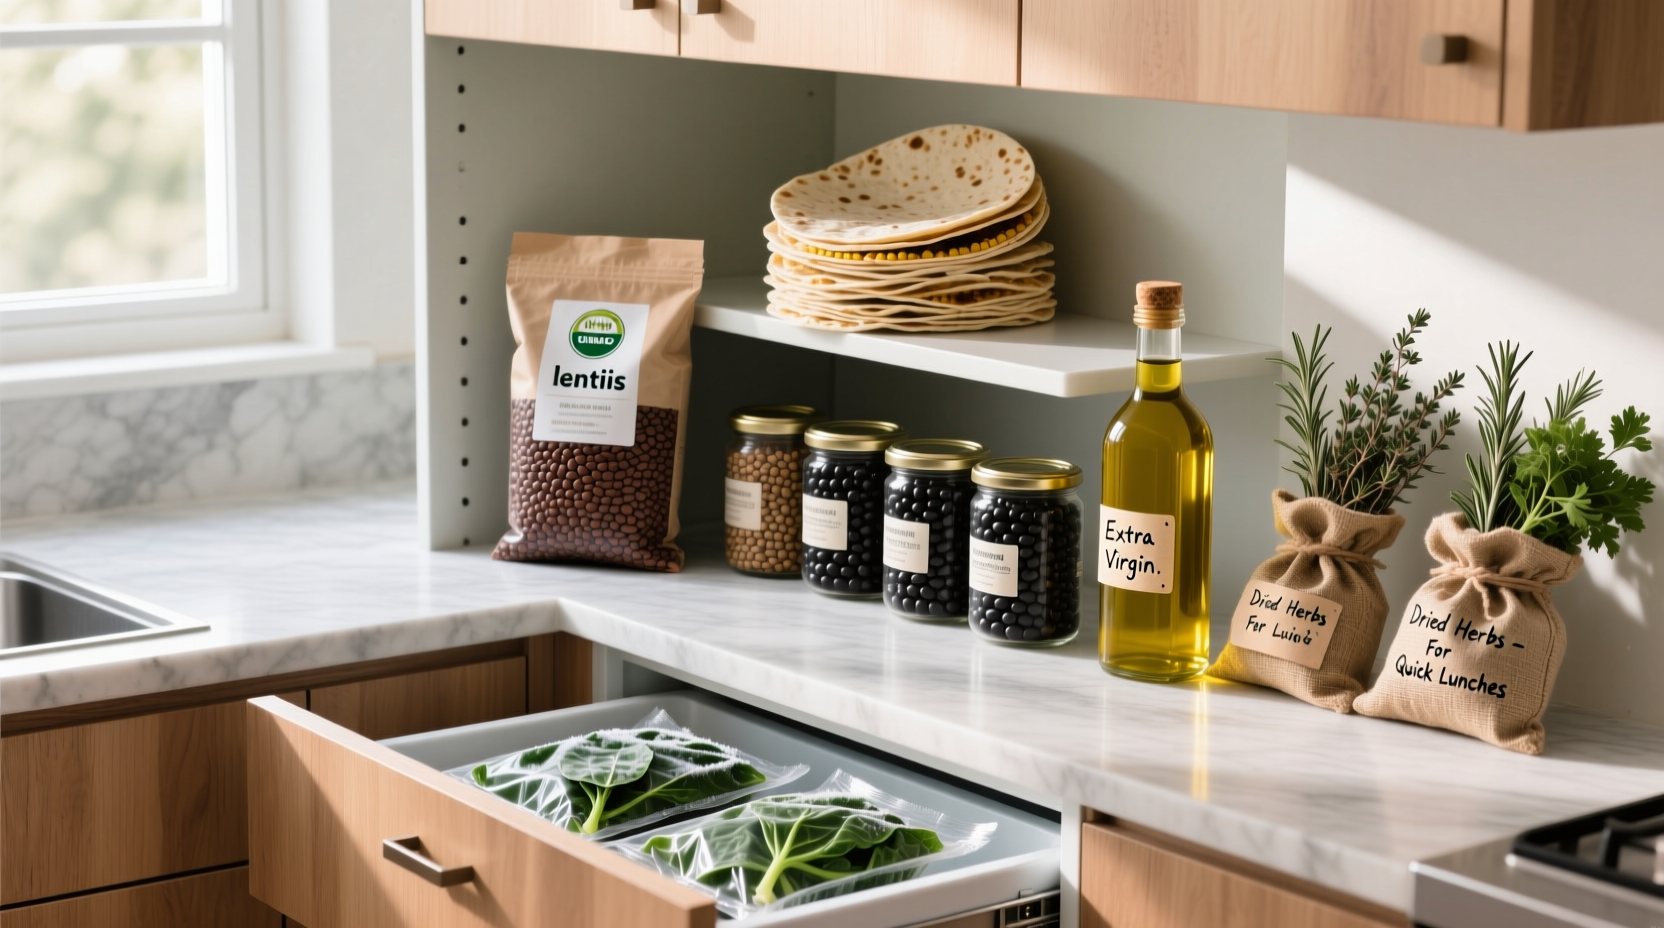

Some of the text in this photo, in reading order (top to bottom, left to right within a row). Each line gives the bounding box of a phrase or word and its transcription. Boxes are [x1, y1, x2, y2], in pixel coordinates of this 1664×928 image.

[553, 365, 626, 391] lentiis
[1105, 519, 1155, 546] Extra
[1286, 599, 1327, 627] Herbs
[1409, 603, 1452, 632] Dried
[1454, 618, 1506, 649] Herbs
[1426, 639, 1452, 659] For
[1395, 653, 1508, 699] Quick Lunches
